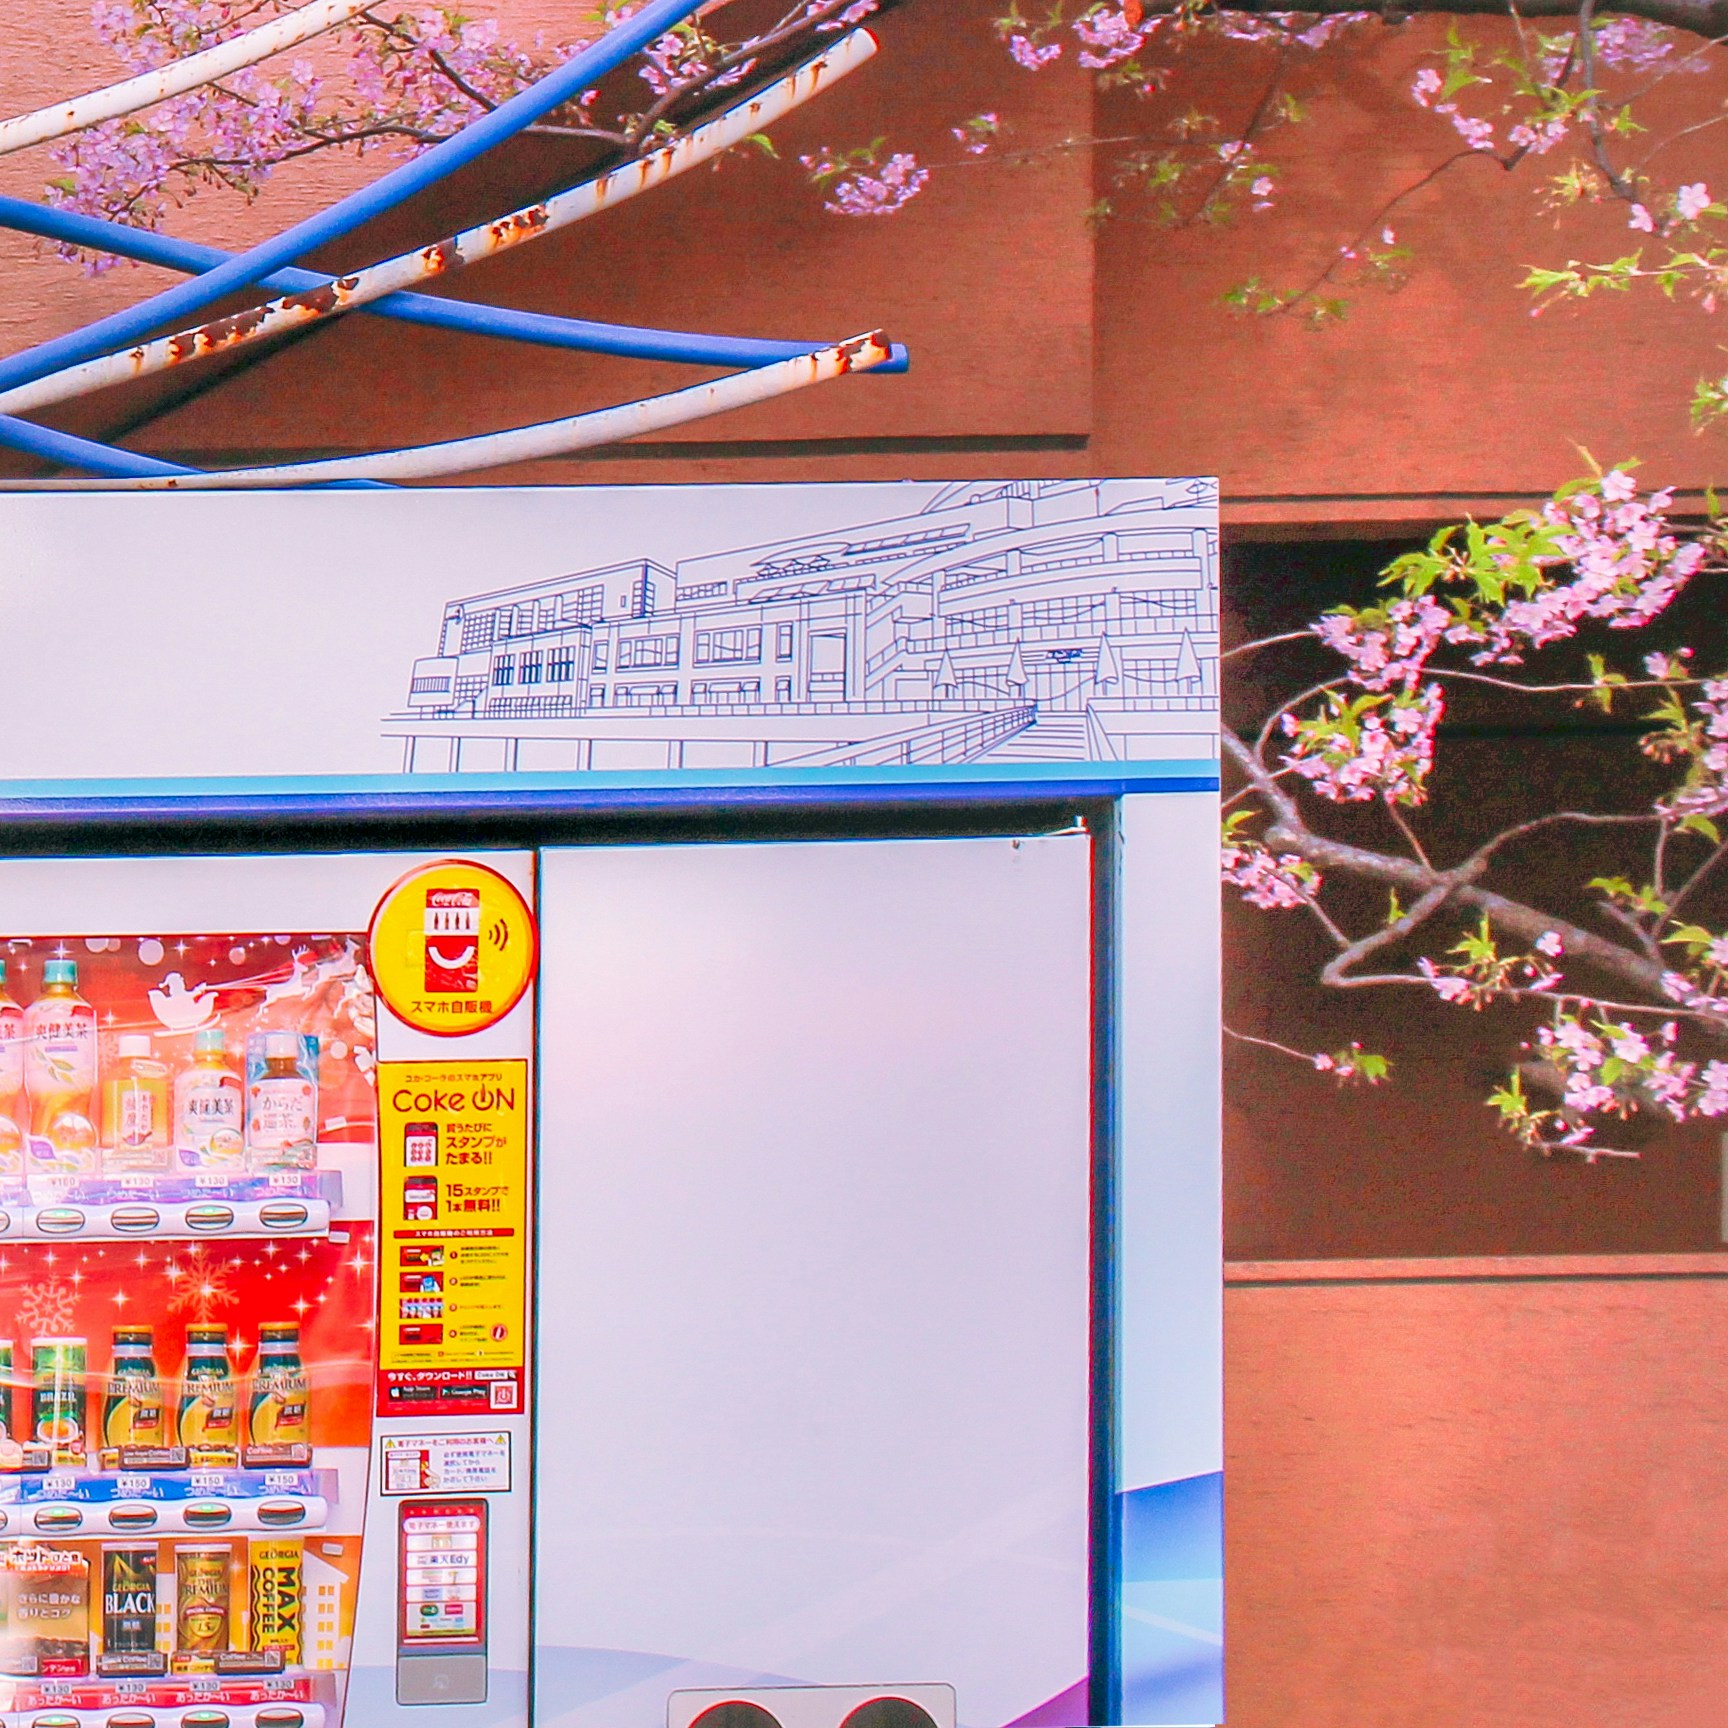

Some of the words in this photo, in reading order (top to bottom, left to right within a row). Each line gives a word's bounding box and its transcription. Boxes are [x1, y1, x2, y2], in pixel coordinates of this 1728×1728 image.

[411, 1001, 493, 1014] スマホ自販機
[35, 1022, 88, 1040] 爽健美茶
[393, 1089, 465, 1112] Coke
[472, 1083, 515, 1111] ON
[263, 1097, 303, 1112] からだ
[446, 1123, 492, 1133] 買うたびに
[446, 1136, 506, 1148] スタンプが
[446, 1184, 509, 1197] 15スタンプで
[446, 1199, 500, 1212] 1本無料!!
[120, 1478, 147, 1488] ¥150
[195, 1476, 221, 1486] ¥150
[268, 1475, 295, 1485] ¥150
[259, 1549, 299, 1559] GEORGIA
[18, 1593, 80, 1604] さらに豊かな
[105, 1592, 156, 1614] BLACK
[262, 1567, 275, 1634] COFFEE
[278, 1567, 296, 1632] MAX
[18, 1608, 71, 1619] 香りとコク
